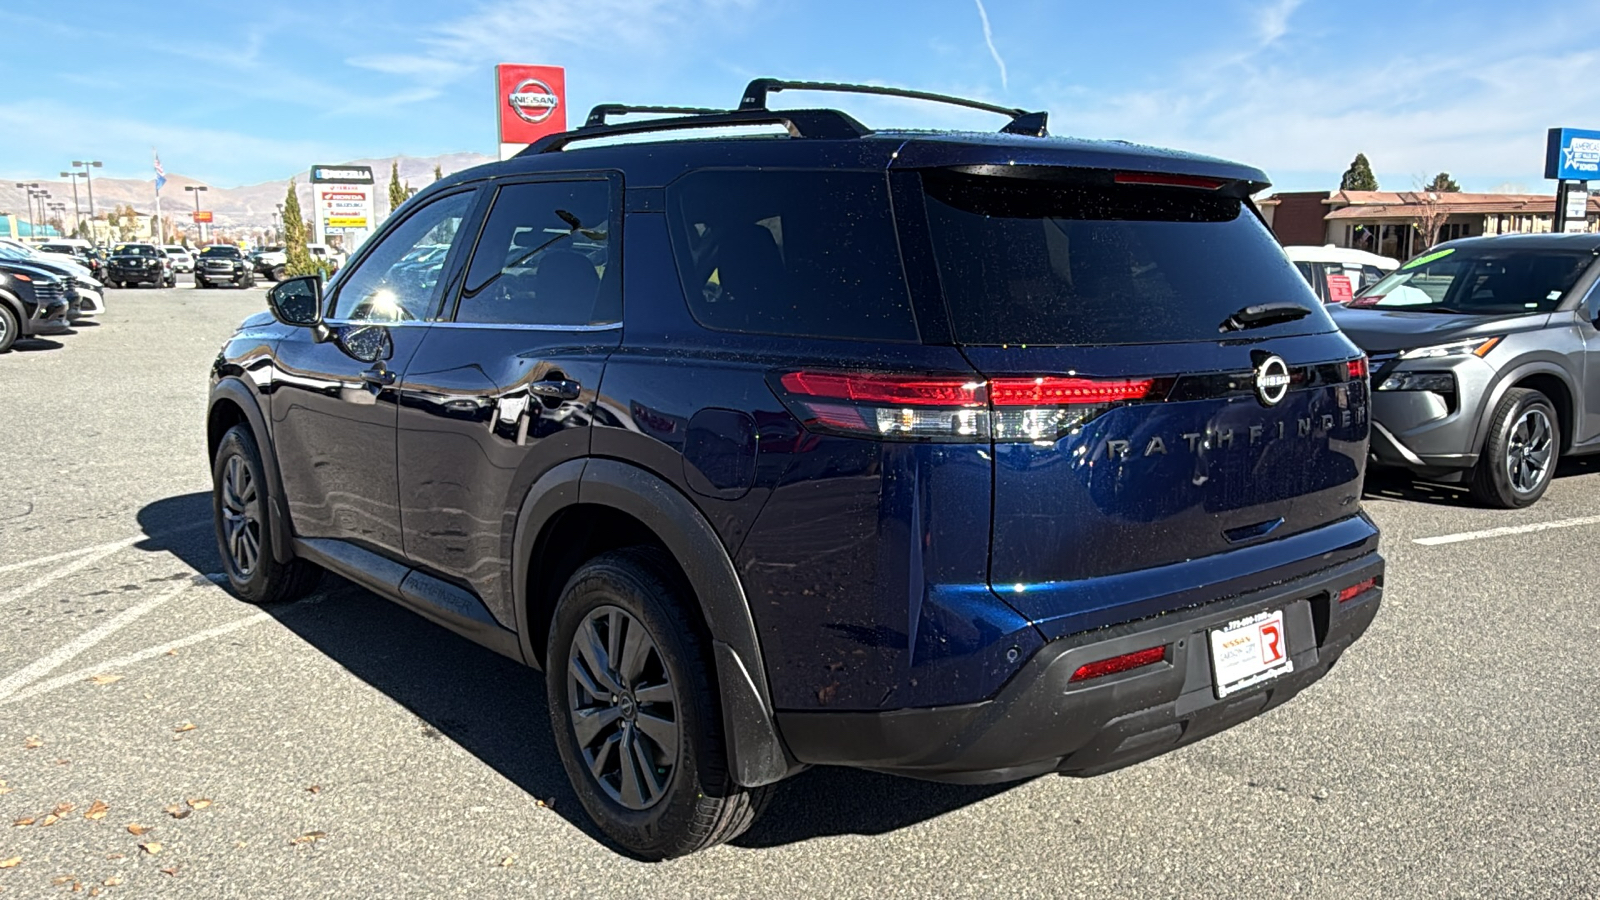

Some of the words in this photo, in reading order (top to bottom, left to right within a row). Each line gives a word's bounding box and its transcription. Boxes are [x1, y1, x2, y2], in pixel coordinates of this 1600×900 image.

[514, 96, 555, 105] NISSAN
[1257, 374, 1290, 387] NISSAN
[1106, 406, 1366, 460] PATHFINDER
[1222, 636, 1251, 649] NISSAN
